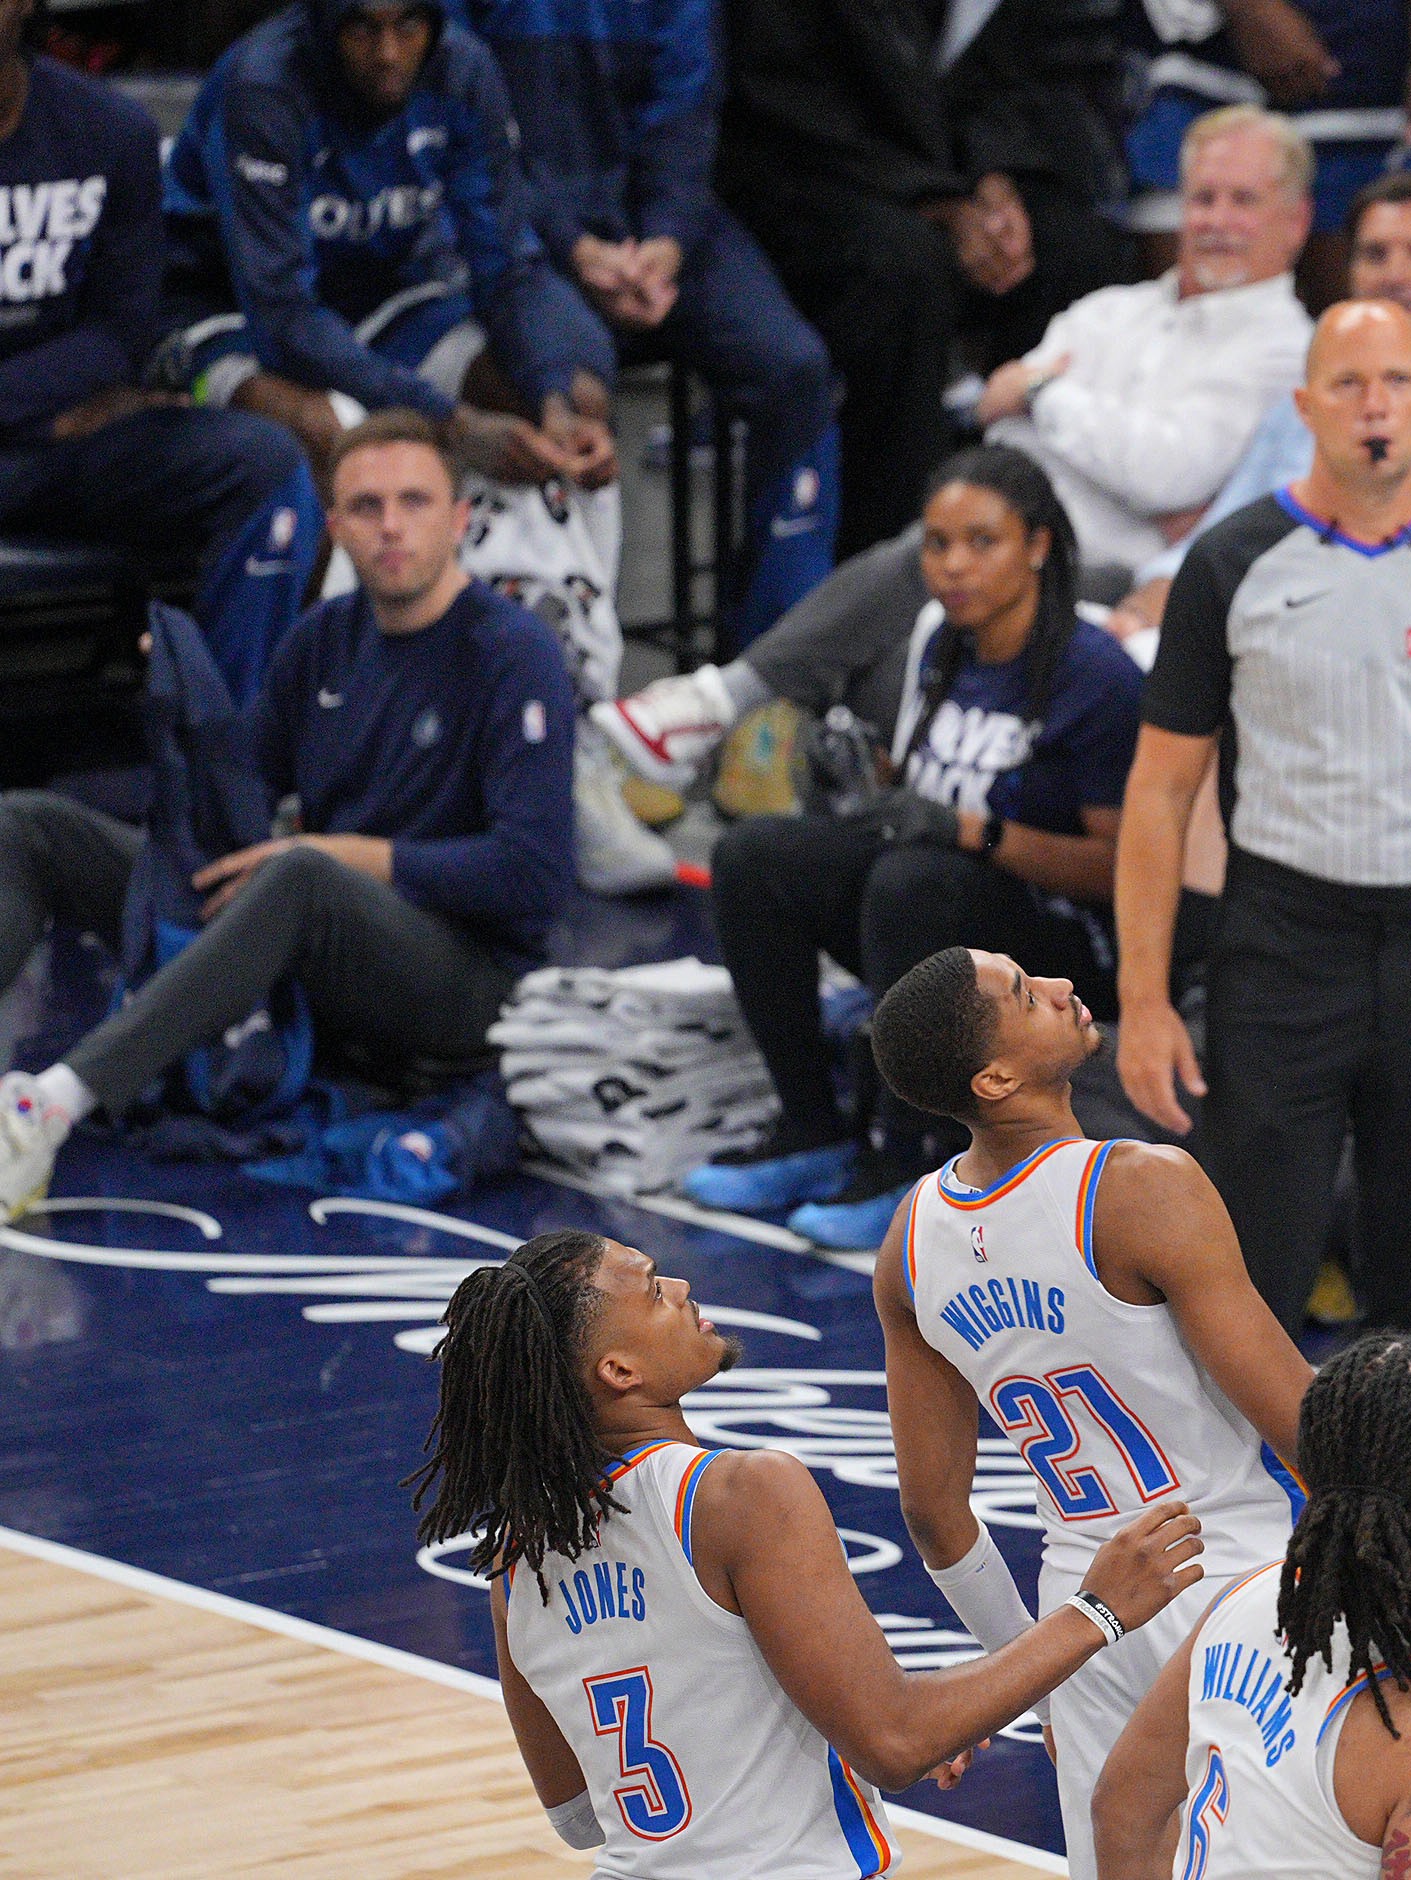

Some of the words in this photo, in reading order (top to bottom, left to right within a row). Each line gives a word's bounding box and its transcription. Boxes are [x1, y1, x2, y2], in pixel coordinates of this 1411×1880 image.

[0, 239, 74, 301] CK
[939, 1276, 1065, 1352] WIGGINS
[989, 1363, 1182, 1522] 21
[558, 1561, 646, 1635] JONES
[582, 1665, 693, 1842] 3
[1200, 1642, 1296, 1768] WILLIAMS
[1181, 1743, 1231, 1880] 6
